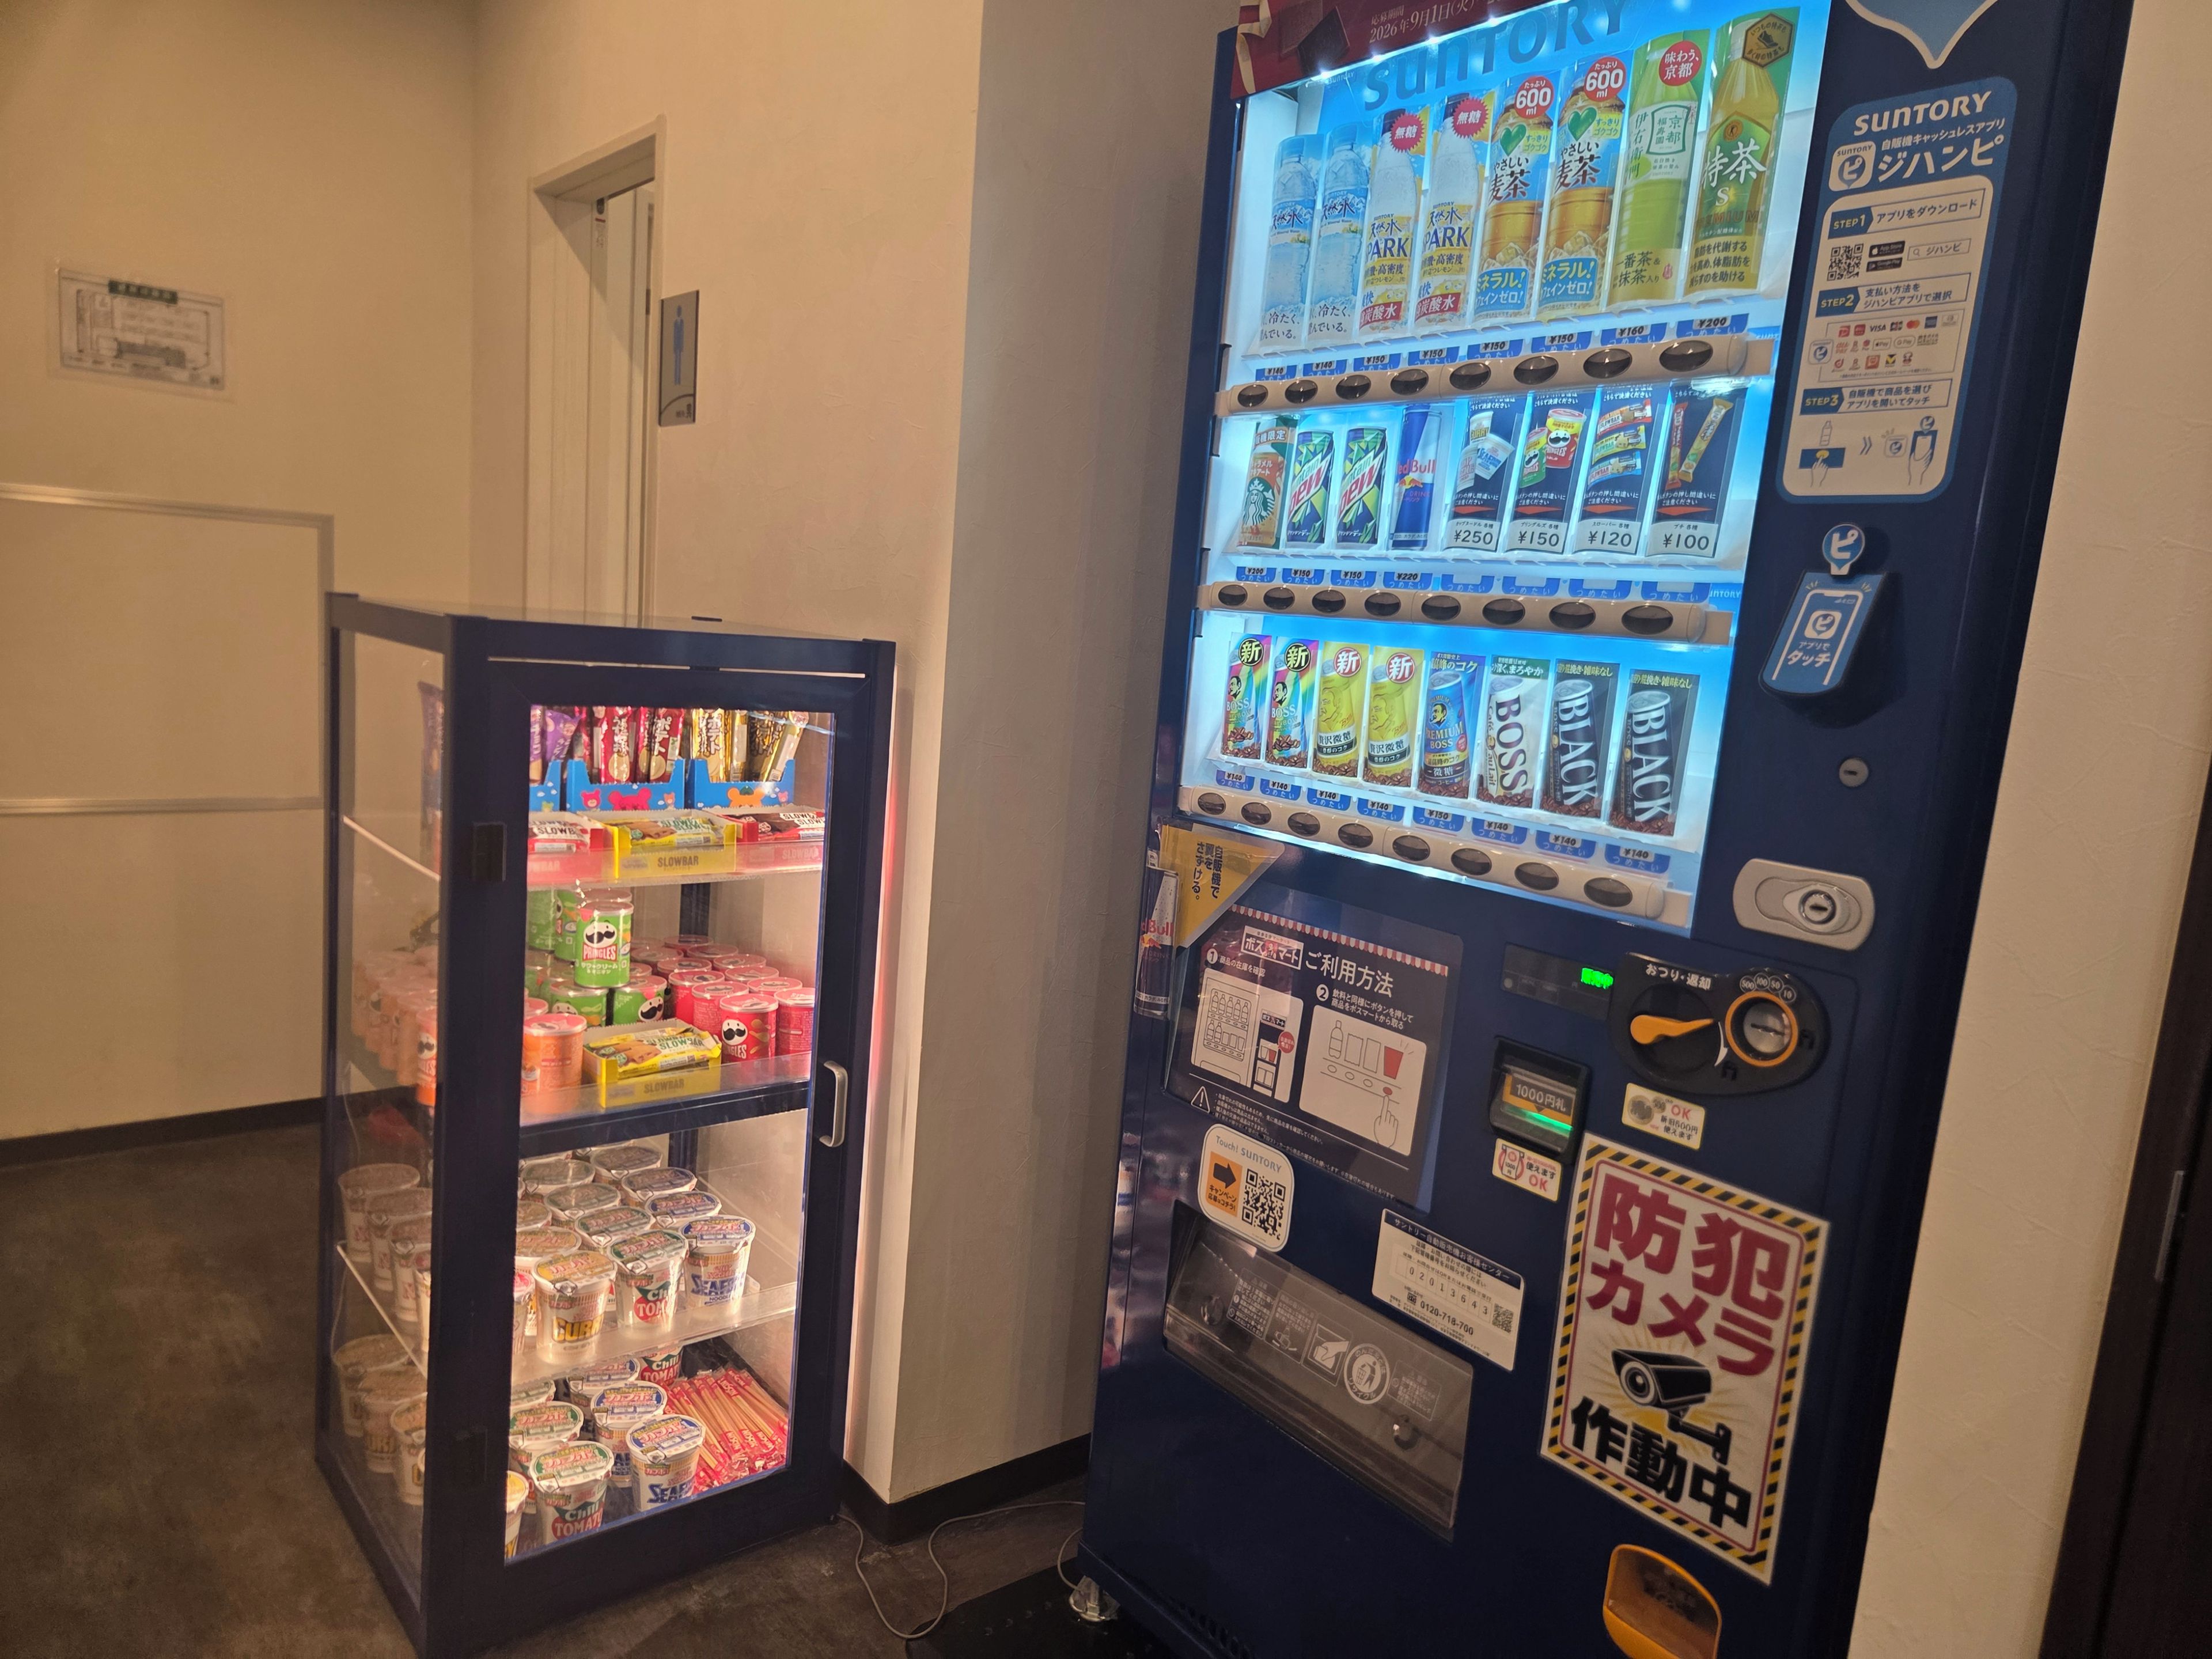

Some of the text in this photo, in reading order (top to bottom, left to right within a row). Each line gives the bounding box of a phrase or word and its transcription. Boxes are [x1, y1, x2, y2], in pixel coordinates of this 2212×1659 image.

[1664, 48, 1700, 64] 味わう、
[1594, 60, 1618, 71] たっぷり
[1663, 63, 1693, 79] 京都
[1524, 80, 1546, 89] たっぷり
[1586, 67, 1624, 92] 600
[1516, 87, 1552, 109] 600
[1596, 89, 1608, 99] ml
[1456, 108, 1482, 125] 無糖
[1526, 106, 1537, 115] ml
[1853, 90, 1992, 136] SUNTORY
[1595, 118, 1620, 127] すっきり
[1665, 115, 1683, 145] 京都
[1393, 124, 1418, 139] 無糖
[1525, 134, 1548, 142] すっきり
[1594, 127, 1619, 137] ゴクゴク
[1881, 118, 2005, 151] 自販機キャッシュレスアプリ
[1560, 142, 1600, 158] やさしい
[1628, 111, 1649, 180] 伊右衛門
[1836, 145, 1873, 157] SUNTORY
[1702, 137, 1767, 191] 特茶
[1877, 134, 2005, 183] ジハンピ
[1554, 151, 1602, 195] 麦茶
[1715, 186, 1731, 206] S
[1877, 199, 1977, 224] アプリをダウンロード
[1865, 283, 1921, 298] 支払い方法を
[1863, 291, 1952, 309] ジハンピアプリで選択
[1618, 325, 1645, 336] ¥160
[1697, 317, 1728, 328] ¥200
[1870, 324, 1887, 332] VISA
[1482, 341, 1506, 351] ¥150
[1549, 333, 1575, 344] ¥150
[1366, 355, 1385, 365] ¥150
[1422, 349, 1443, 358] ¥150
[1268, 367, 1284, 376] ¥140
[1603, 391, 1652, 402] こちらで決済ください
[1849, 384, 1932, 399] 自販機で商品を選び
[1847, 396, 1930, 410] アプリを開いてタッチ
[1411, 459, 1436, 475] Bull
[1453, 529, 1494, 546] ¥250
[1518, 529, 1560, 547] ¥150
[1588, 530, 1633, 547] ¥120
[1662, 533, 1710, 551] ¥100
[1293, 569, 1311, 578] ¥150
[1343, 571, 1362, 579] ¥150
[1396, 572, 1418, 581] ¥220
[1336, 578, 1369, 587] つめたい
[1446, 583, 1485, 594] つめたい
[1576, 589, 1621, 600] つめたい
[1240, 640, 1262, 664] 新
[1799, 641, 1831, 651] アプリで
[1286, 646, 1309, 671] 新
[1335, 649, 1360, 675] 新
[1787, 650, 1831, 668] タッチ
[1388, 655, 1414, 683] 新
[1226, 698, 1249, 712] BOSS
[1272, 704, 1296, 718] BOSS
[1430, 737, 1453, 749] BOSS
[1494, 694, 1528, 792] BOSS
[1558, 694, 1599, 806] BLACK
[1433, 766, 1453, 777] 微糖
[1632, 705, 1673, 823] BLACK
[1219, 779, 1249, 790] つめたい
[1226, 774, 1243, 782] ¥140
[1270, 781, 1289, 791] ¥140
[1319, 790, 1336, 800] ¥140
[1312, 797, 1344, 810] つめたい
[1370, 800, 1389, 810] ¥140
[1427, 809, 1449, 820] ¥150
[1419, 817, 1456, 831] つめたい
[1486, 820, 1509, 832] ¥140
[1552, 835, 1577, 846] ¥140
[1204, 843, 1214, 870] 翼を
[1543, 841, 1586, 857] つめたい
[1623, 847, 1650, 859] ¥140
[657, 855, 699, 868] SLOWBAR
[1192, 841, 1205, 900] さずける。
[1211, 845, 1224, 899] 自販機で
[1149, 920, 1173, 936] Bull
[583, 945, 617, 961] PRINGLES
[1219, 955, 1266, 978] 商品の在庫を確認
[1305, 950, 1394, 998] ご利用方法
[1645, 963, 1712, 991] おつり・返却
[1332, 988, 1414, 1023] 飲料と同様にボタンを押して
[1331, 999, 1404, 1030] 商品をボスマートから取る
[643, 1078, 685, 1094] SLOWBAR
[1516, 1083, 1567, 1112] 1000円札
[1671, 1103, 1693, 1121] OK
[1663, 1126, 1694, 1141] 使えます
[1215, 1135, 1282, 1173] Touch! SUNTORY
[1525, 1160, 1556, 1180] 使えます
[1528, 1172, 1550, 1192] OK
[1209, 1184, 1237, 1202] キャンペーン
[1394, 1218, 1511, 1281] サントリー自動販売機お客様センター
[1594, 1172, 1790, 1321] 防犯
[1419, 1301, 1474, 1336] 0120-718-700
[1586, 1260, 1777, 1377] カメラ
[1570, 1395, 1752, 1529] 作動中
